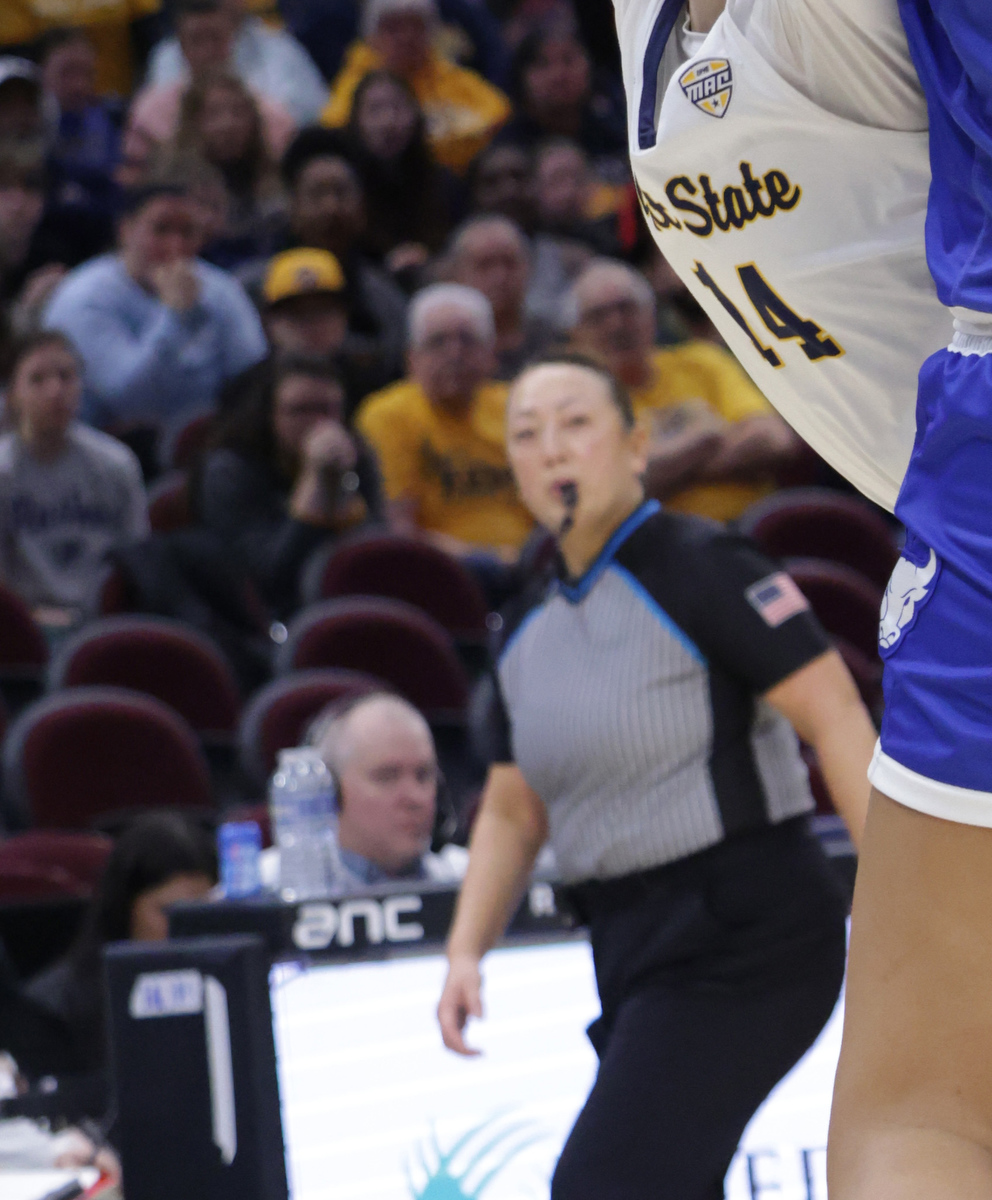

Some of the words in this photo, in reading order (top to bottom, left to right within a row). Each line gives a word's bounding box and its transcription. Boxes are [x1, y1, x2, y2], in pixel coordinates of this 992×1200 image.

[685, 69, 733, 103] MAC
[664, 160, 802, 238] State
[690, 259, 846, 369] 14
[292, 894, 425, 949] anc
